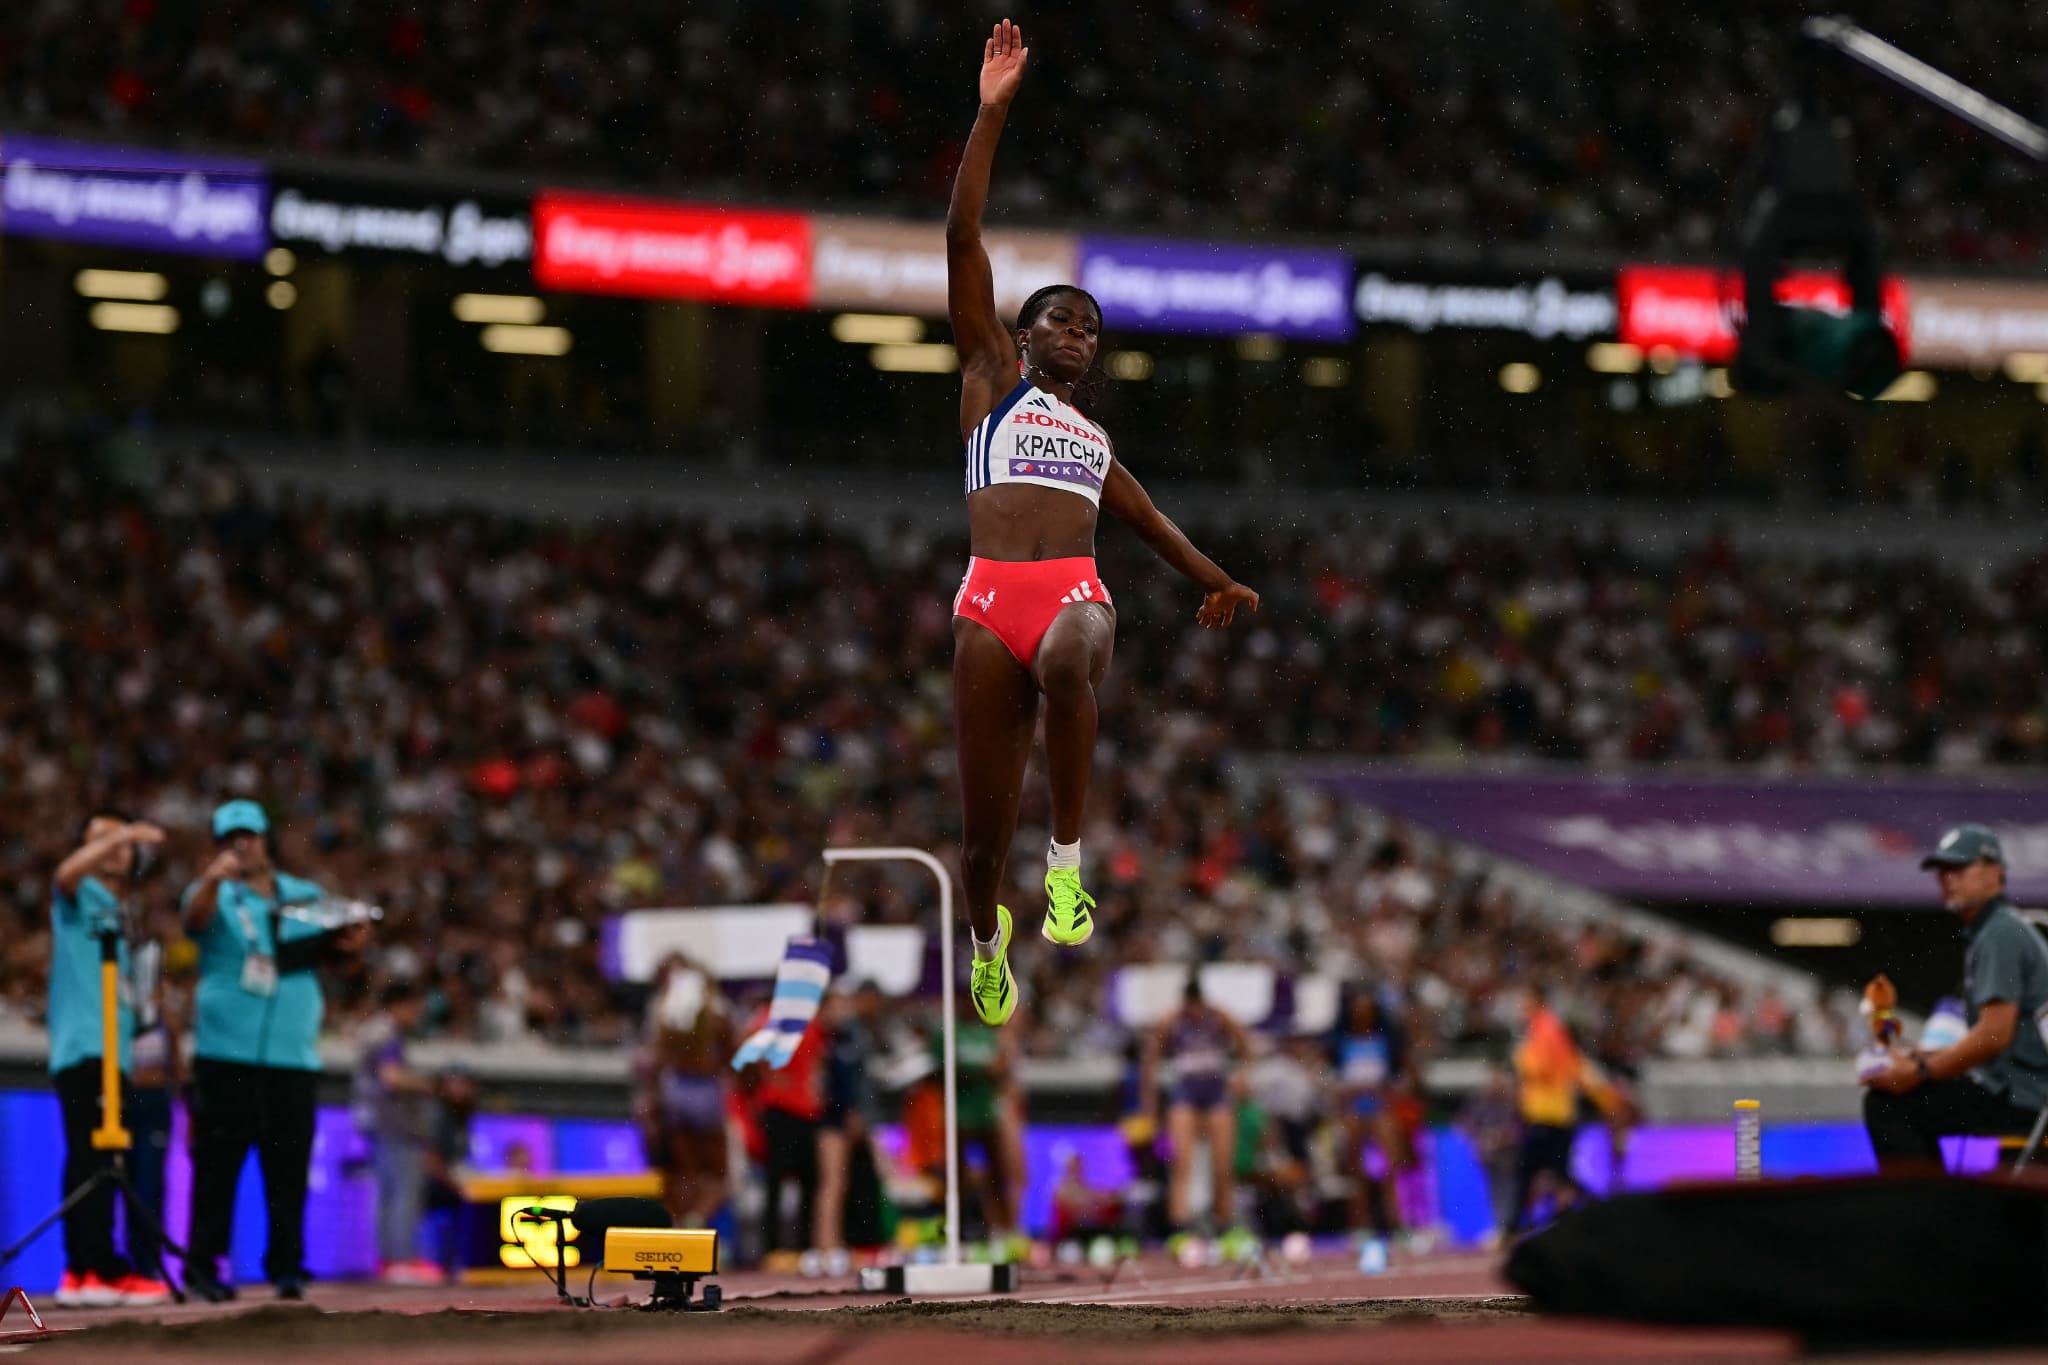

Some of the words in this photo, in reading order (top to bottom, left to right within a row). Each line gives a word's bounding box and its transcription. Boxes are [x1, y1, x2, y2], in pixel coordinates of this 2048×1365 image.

[1013, 411, 1107, 448] HONDA
[1015, 434, 1104, 474] KPATCHA
[635, 1252, 684, 1262] SEIKO
